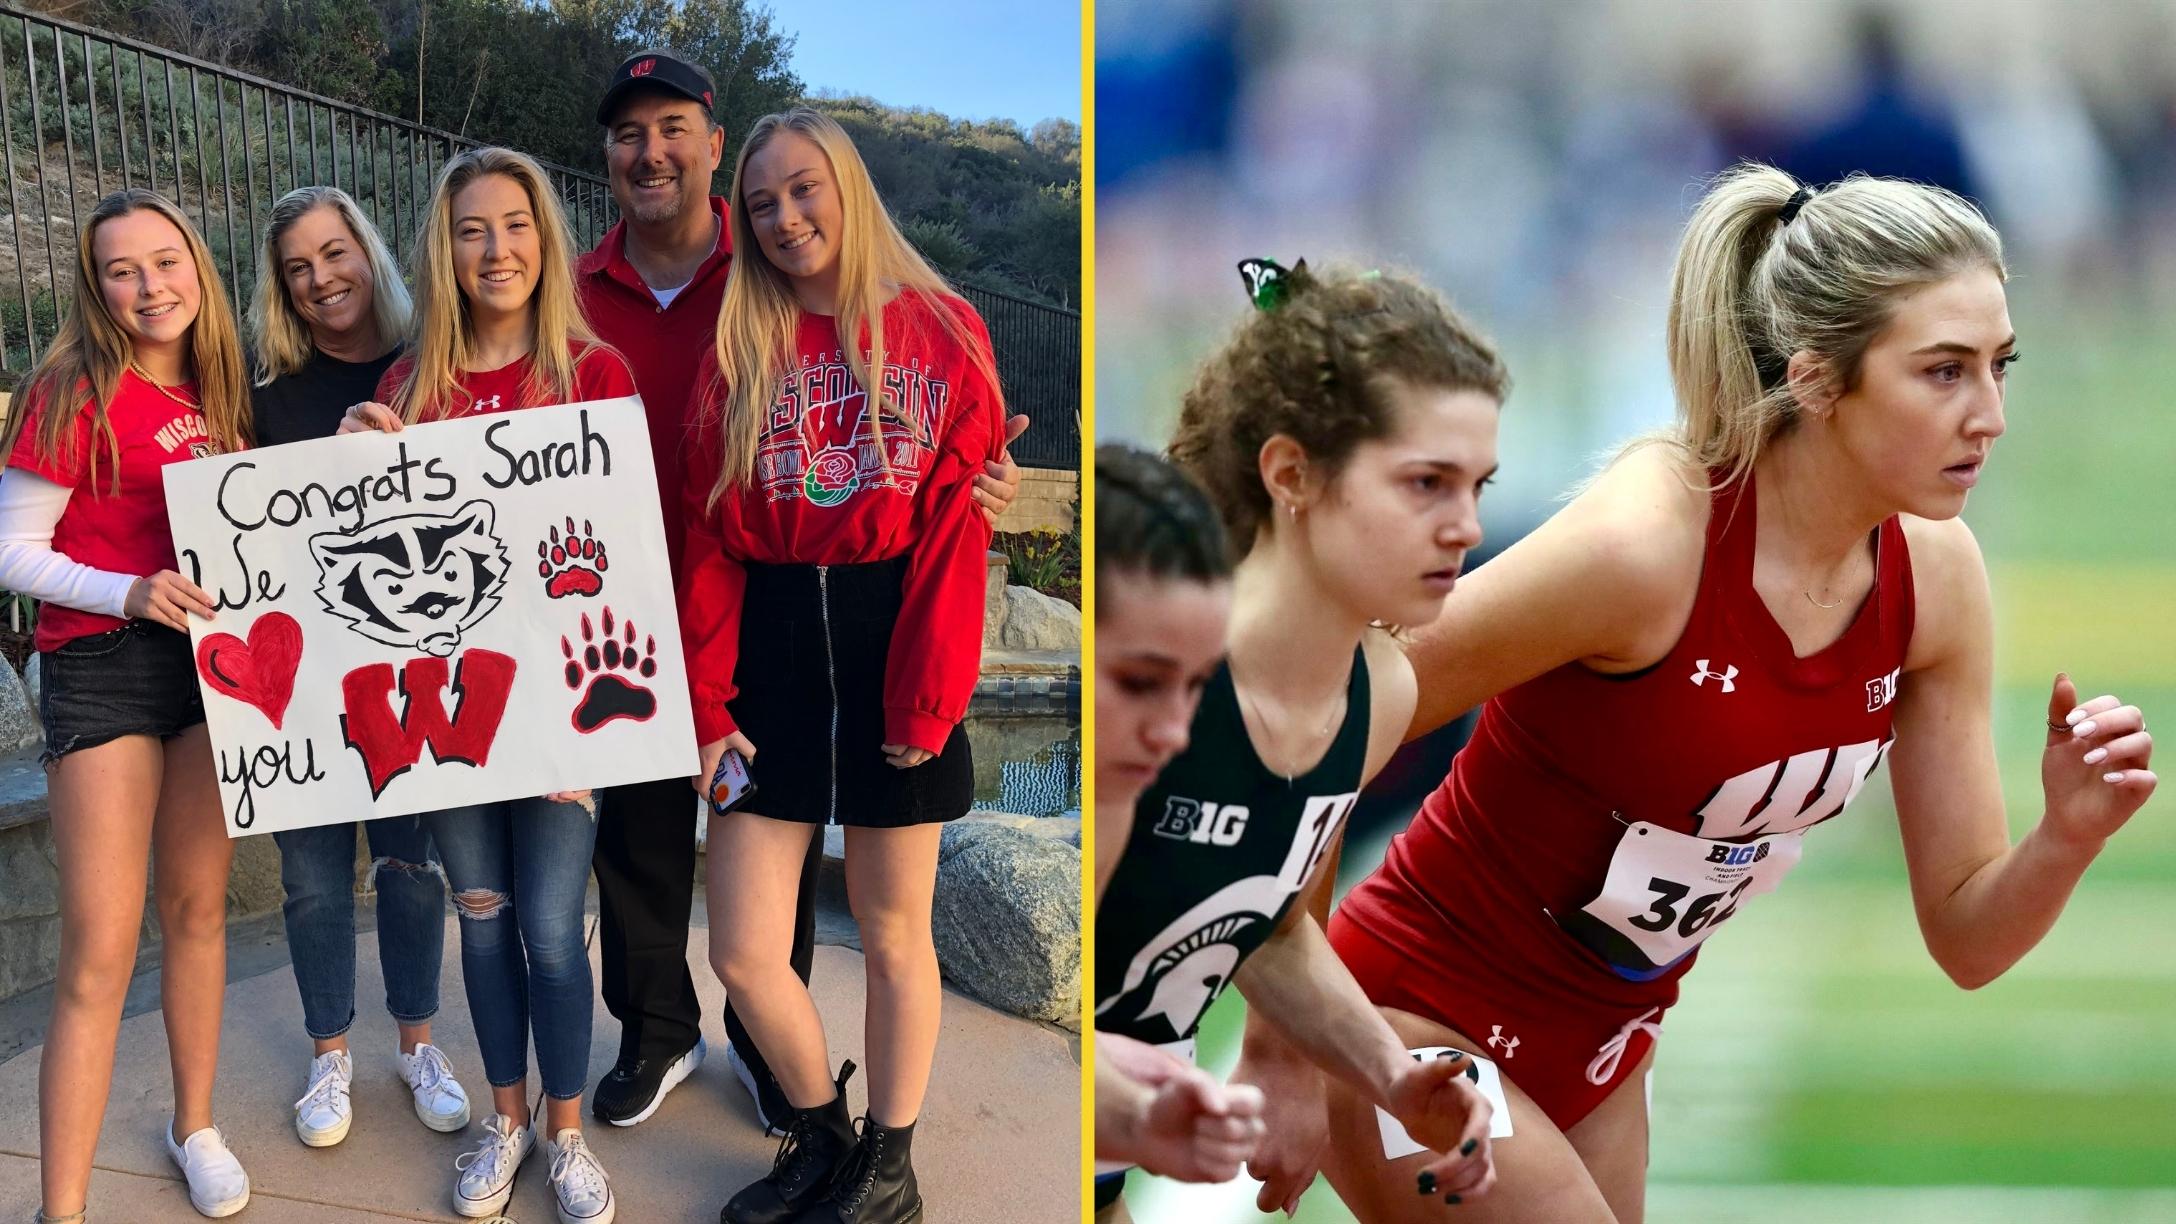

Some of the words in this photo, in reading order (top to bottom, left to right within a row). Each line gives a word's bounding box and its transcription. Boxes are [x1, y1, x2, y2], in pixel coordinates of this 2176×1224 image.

[912, 357, 932, 376] OF
[154, 414, 208, 454] WISCO
[798, 391, 869, 453] W
[216, 442, 456, 532] Congrats
[483, 409, 611, 489] Sarah
[774, 449, 805, 477] BOWL
[893, 441, 919, 468] 2011
[183, 533, 287, 611] We
[339, 647, 517, 802] W
[221, 738, 326, 829] you
[1627, 876, 1754, 938] 362
